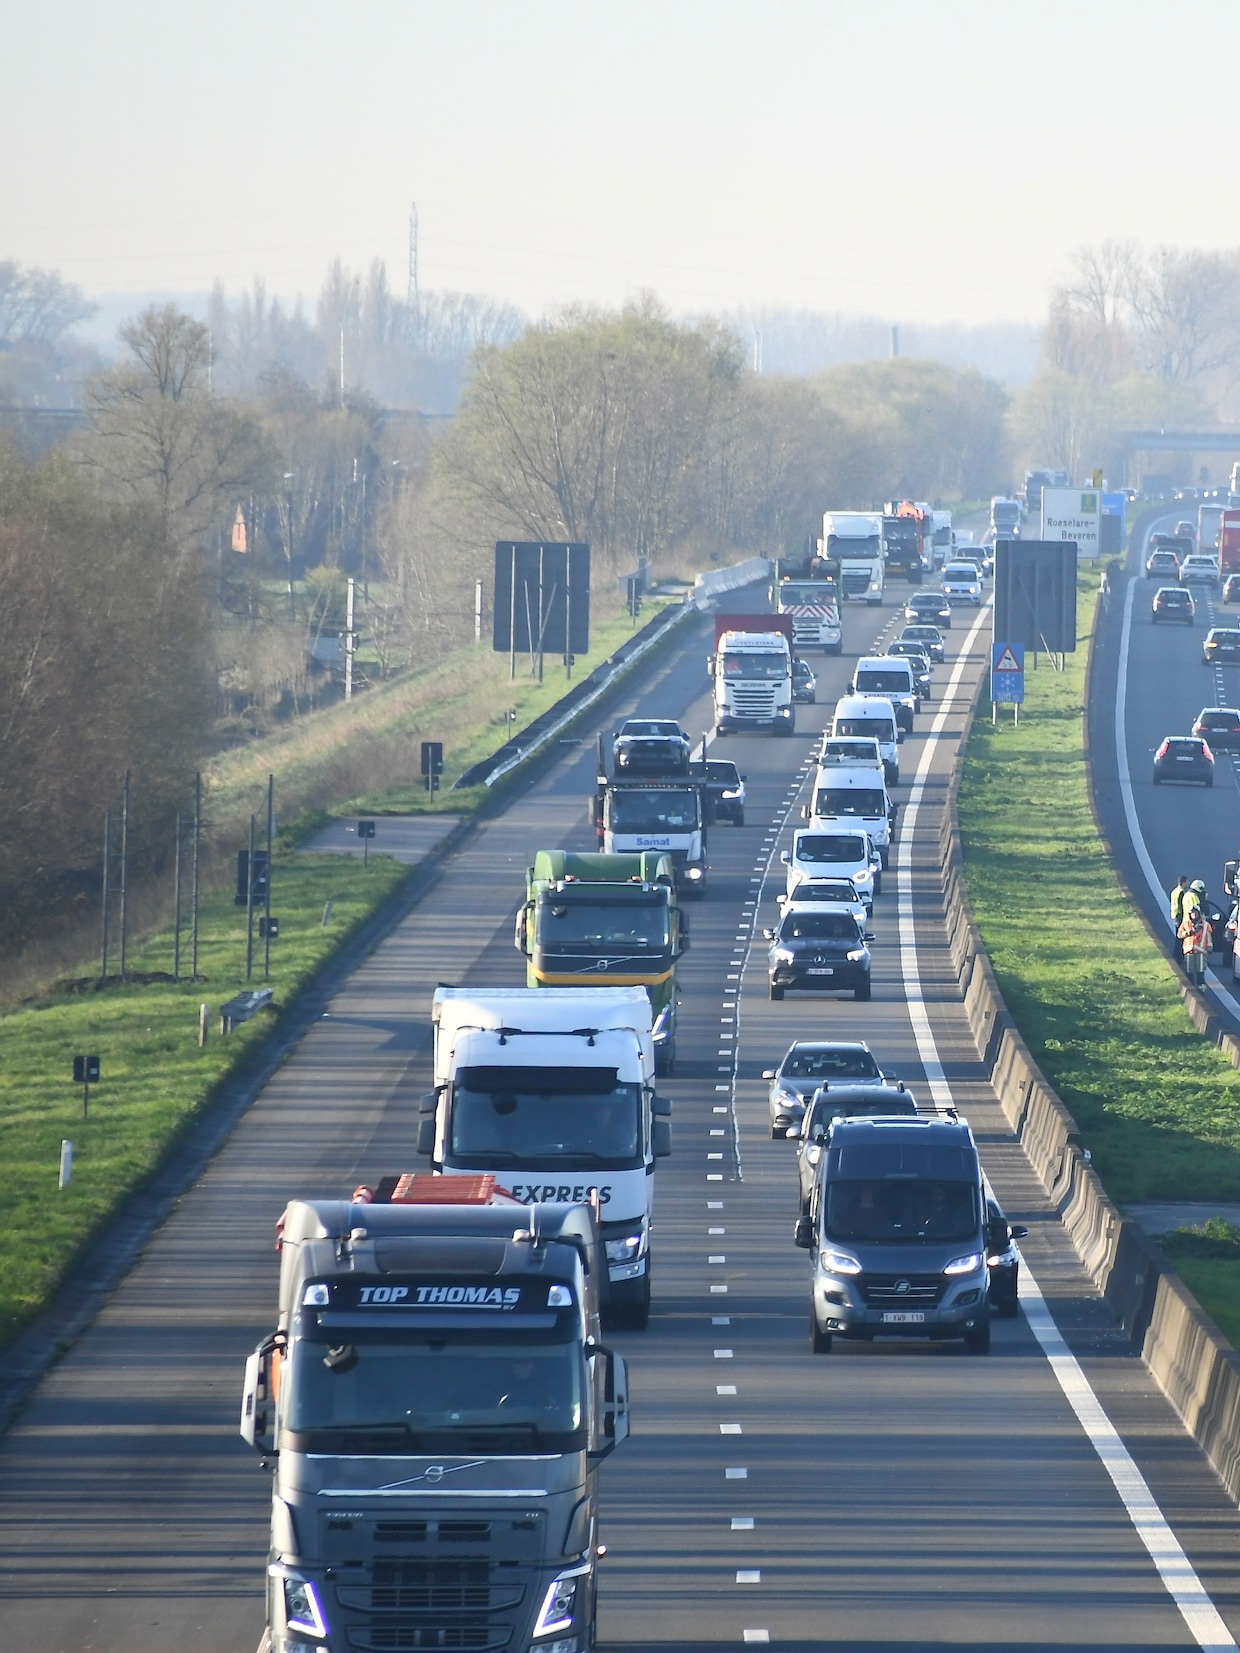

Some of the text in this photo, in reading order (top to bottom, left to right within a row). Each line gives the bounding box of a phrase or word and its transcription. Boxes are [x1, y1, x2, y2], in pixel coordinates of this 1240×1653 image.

[1047, 518, 1095, 527] Roeselare-
[1061, 531, 1096, 540] Beveren
[636, 836, 671, 846] Samat
[511, 1185, 612, 1204] EXPRESS
[359, 1286, 521, 1304] TOP THOMAS
